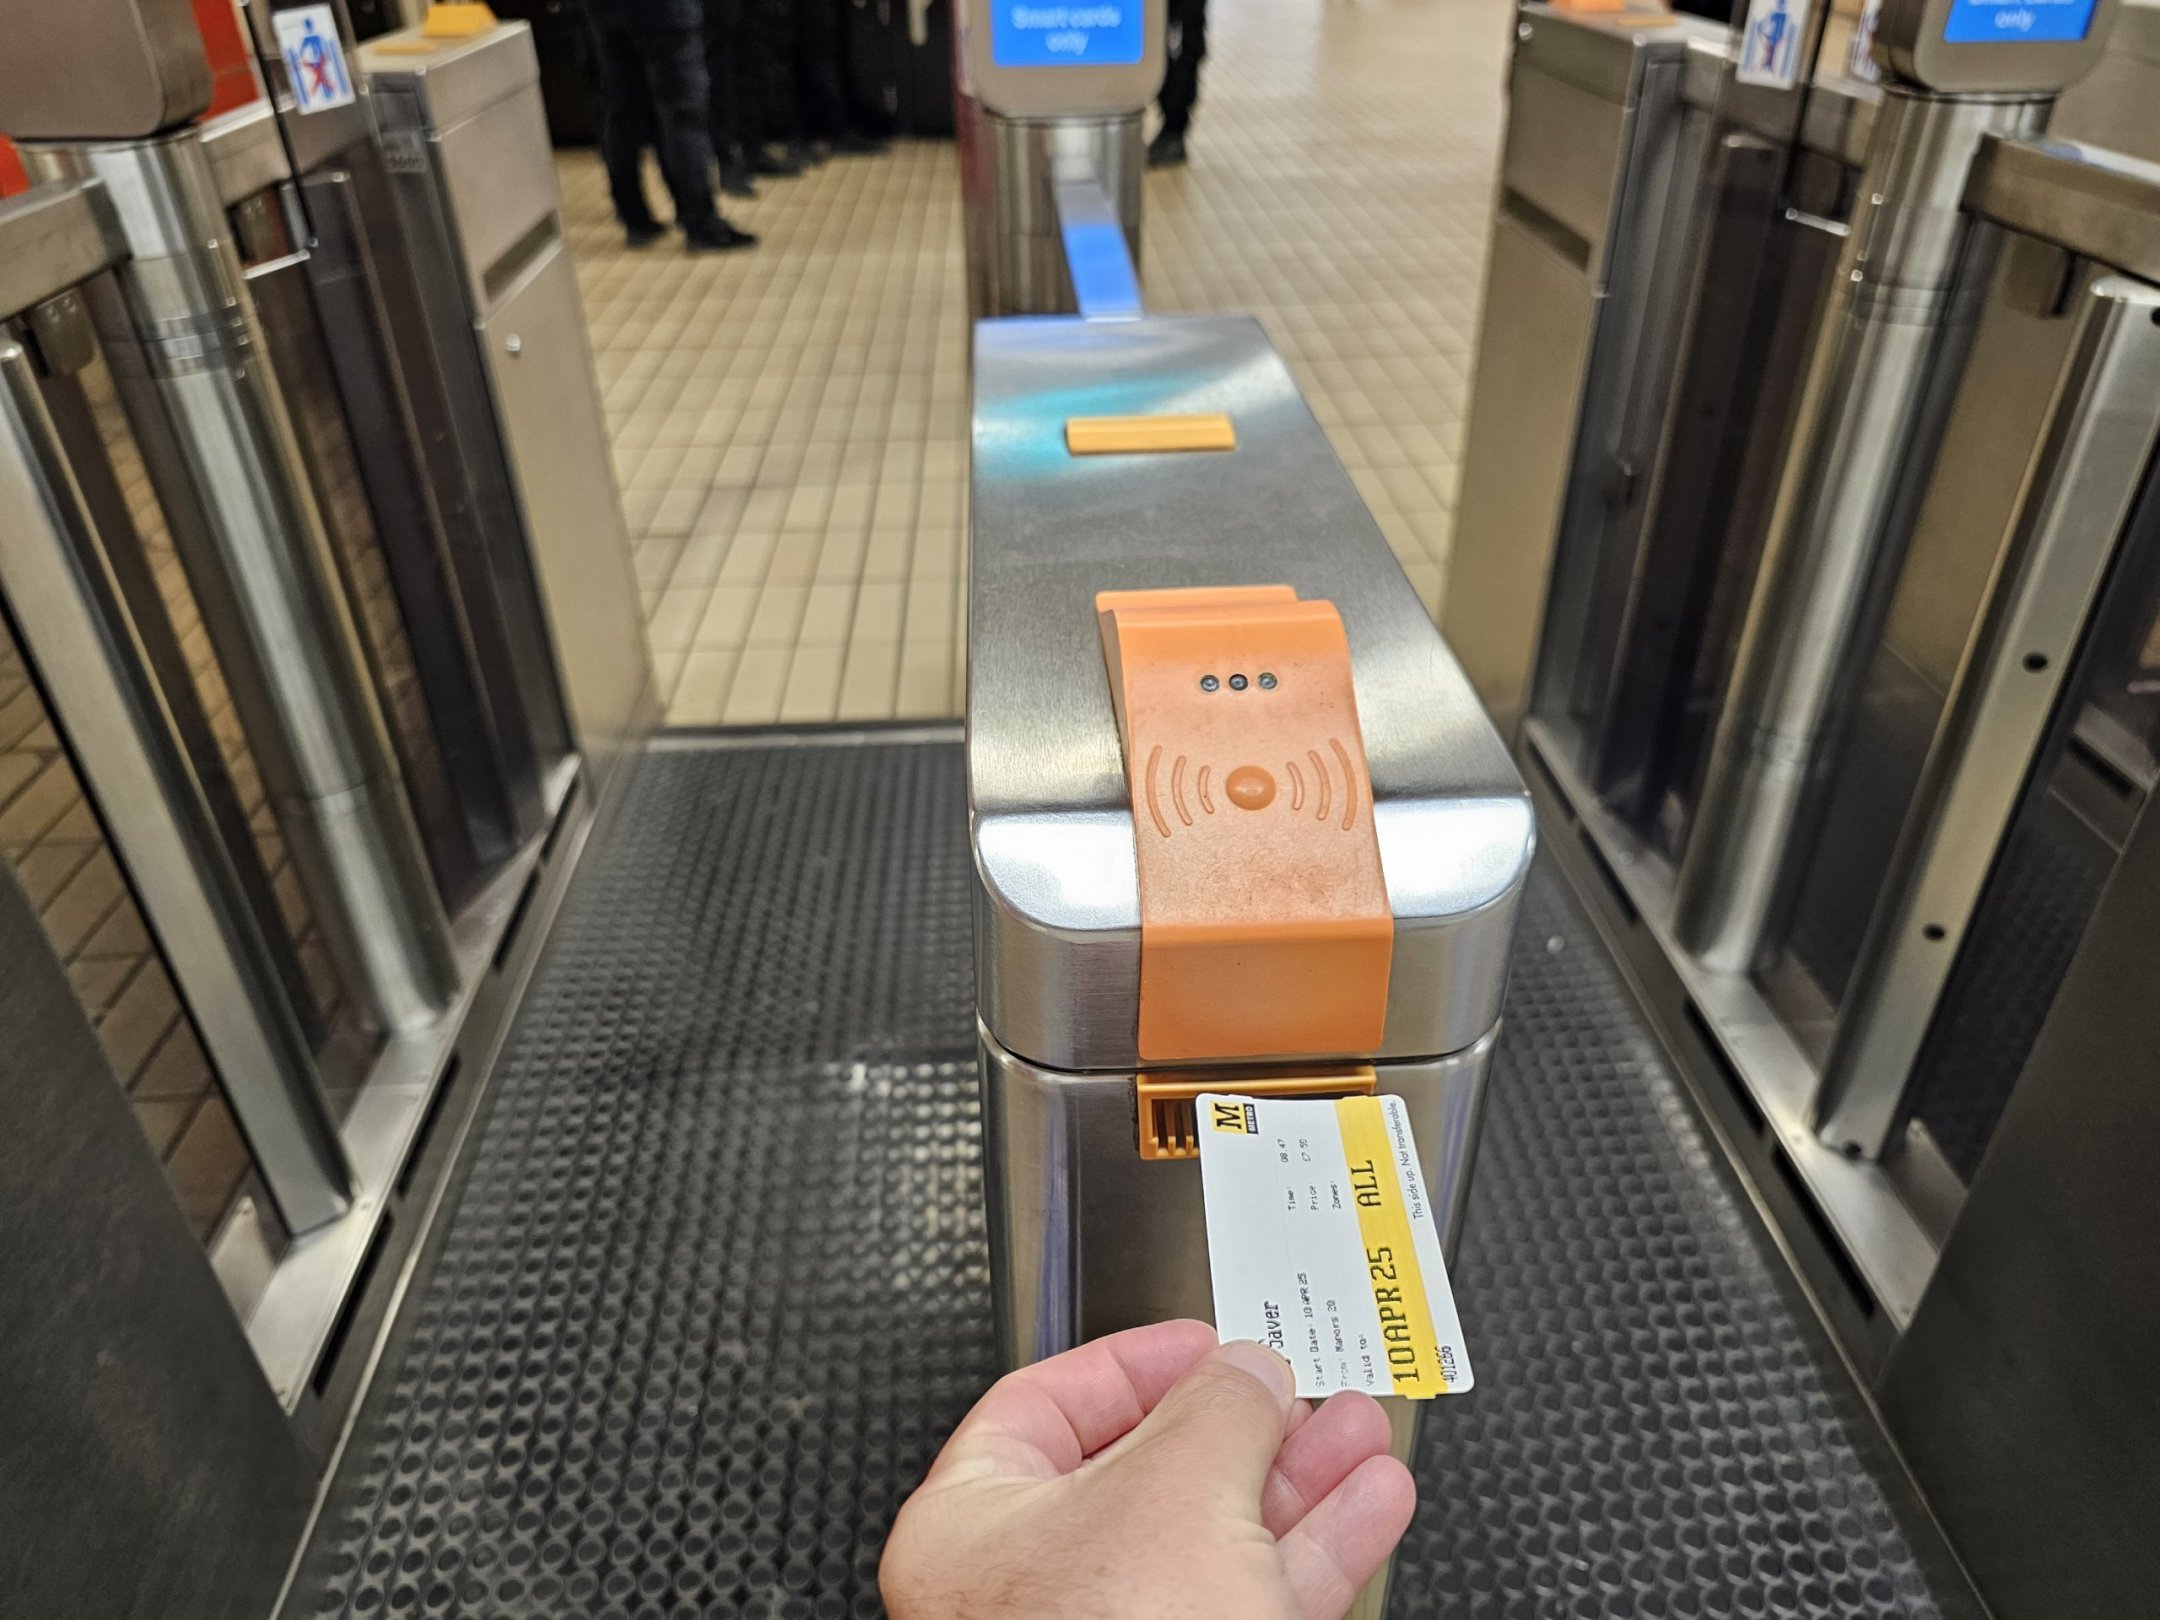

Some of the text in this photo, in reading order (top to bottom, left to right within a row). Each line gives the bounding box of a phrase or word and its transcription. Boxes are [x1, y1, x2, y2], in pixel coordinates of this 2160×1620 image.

[1011, 5, 1122, 29] Smart cards
[1994, 8, 2037, 32] only
[1045, 32, 1089, 55] only
[1215, 1103, 1242, 1130] M
[1246, 1106, 1256, 1132] METRO
[1388, 1100, 1424, 1219] This side up. Not transferable.
[1351, 1160, 1382, 1207] ALL
[1332, 1316, 1344, 1352] Manors
[1314, 1358, 1326, 1388] Start
[1362, 1355, 1375, 1386] Valid
